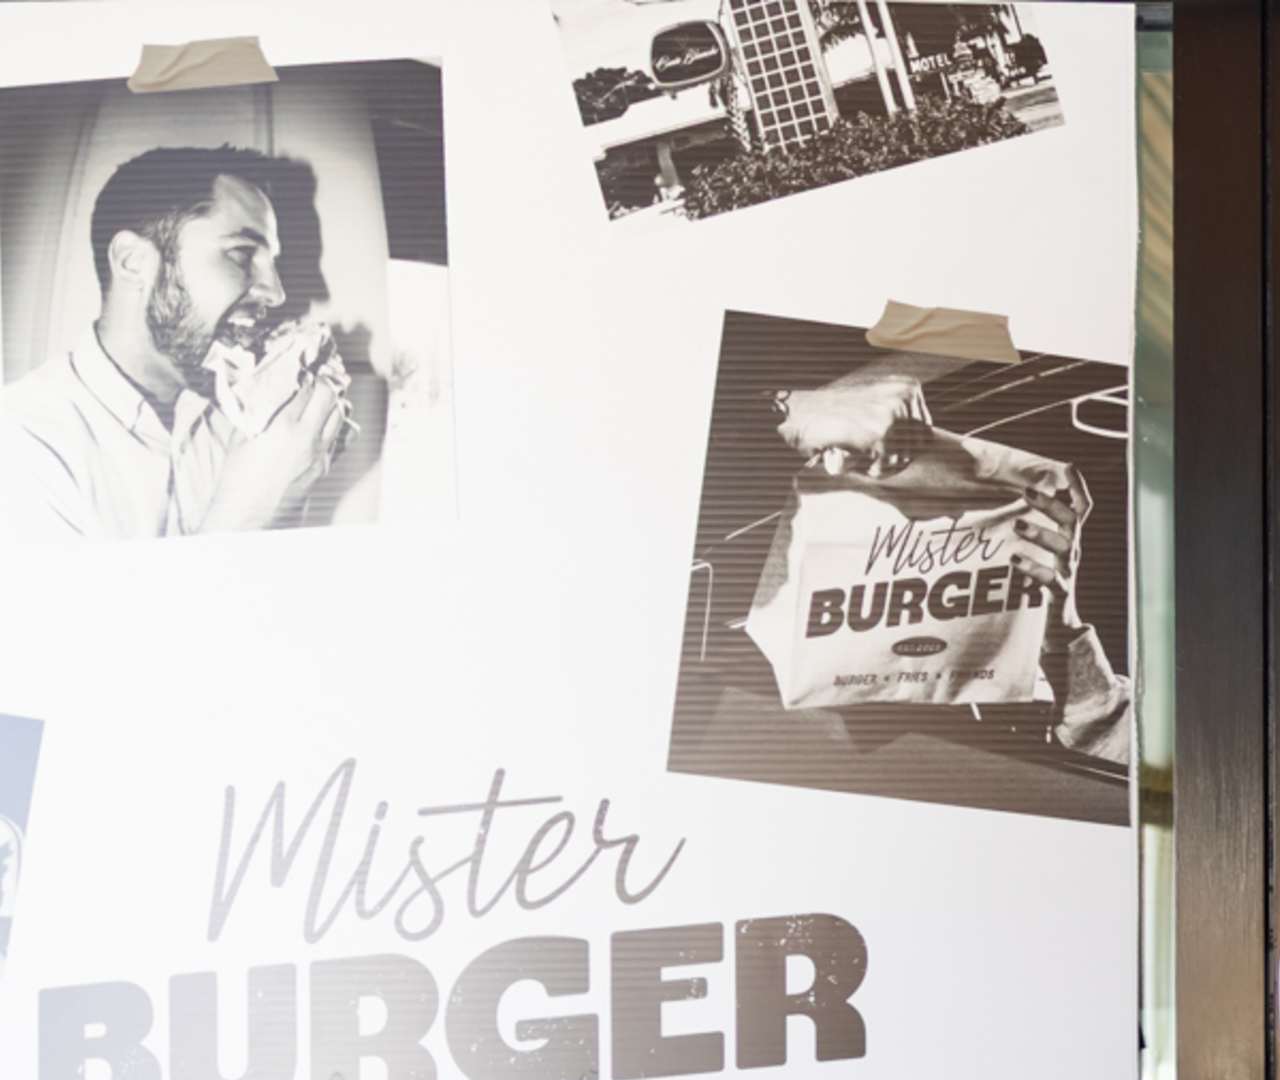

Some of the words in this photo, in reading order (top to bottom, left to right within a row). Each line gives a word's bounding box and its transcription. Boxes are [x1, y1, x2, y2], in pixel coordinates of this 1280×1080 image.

[865, 520, 1005, 577] Mister
[806, 564, 1044, 638] BURGER
[207, 757, 687, 944] Mister
